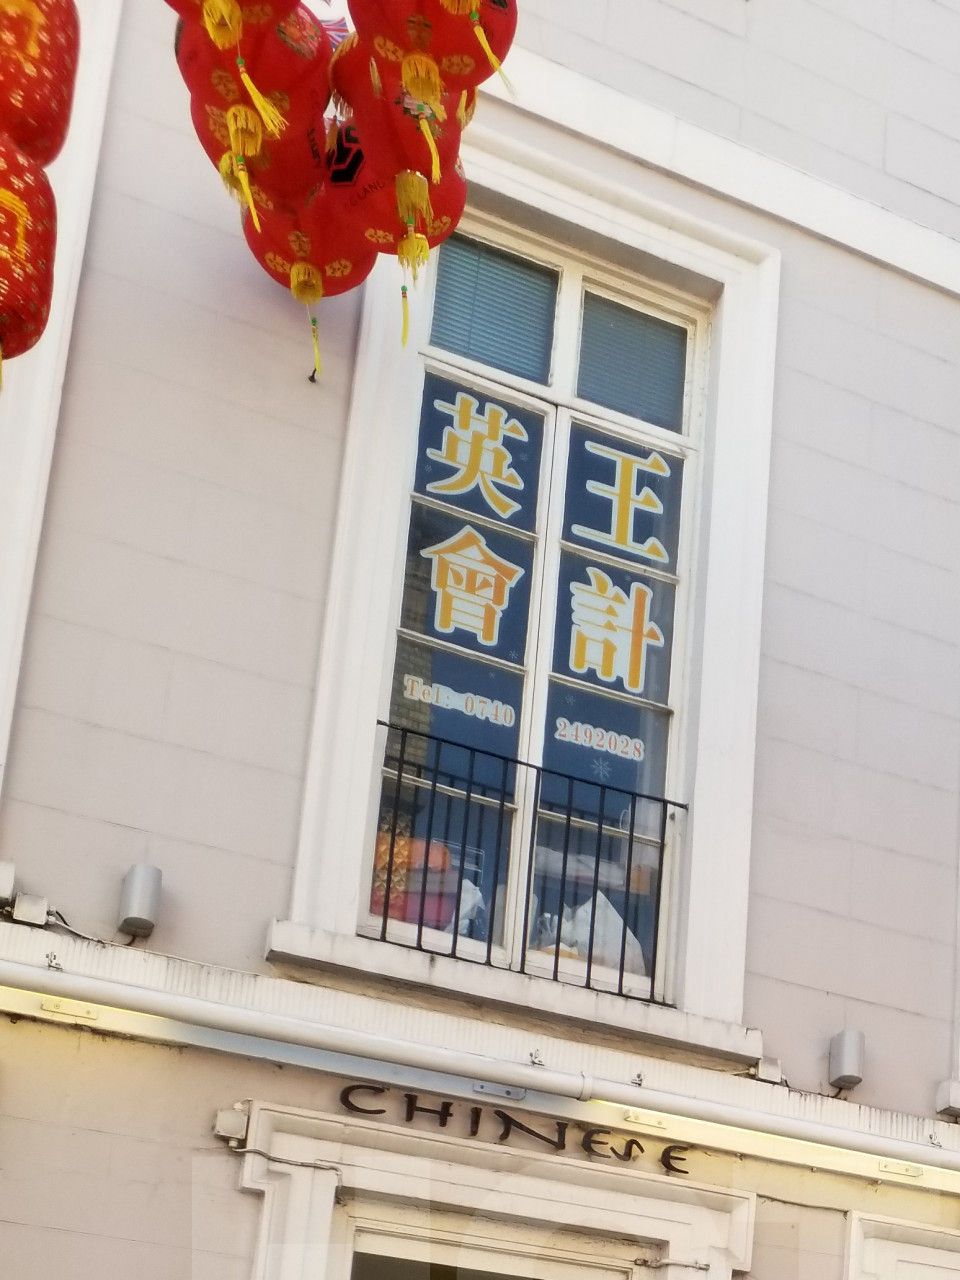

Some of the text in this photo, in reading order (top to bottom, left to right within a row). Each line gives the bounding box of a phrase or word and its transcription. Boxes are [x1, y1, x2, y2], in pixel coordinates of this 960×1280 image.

[461, 688, 516, 727] 0740
[554, 716, 645, 761] 2492028
[339, 1084, 691, 1175] CHINESE
